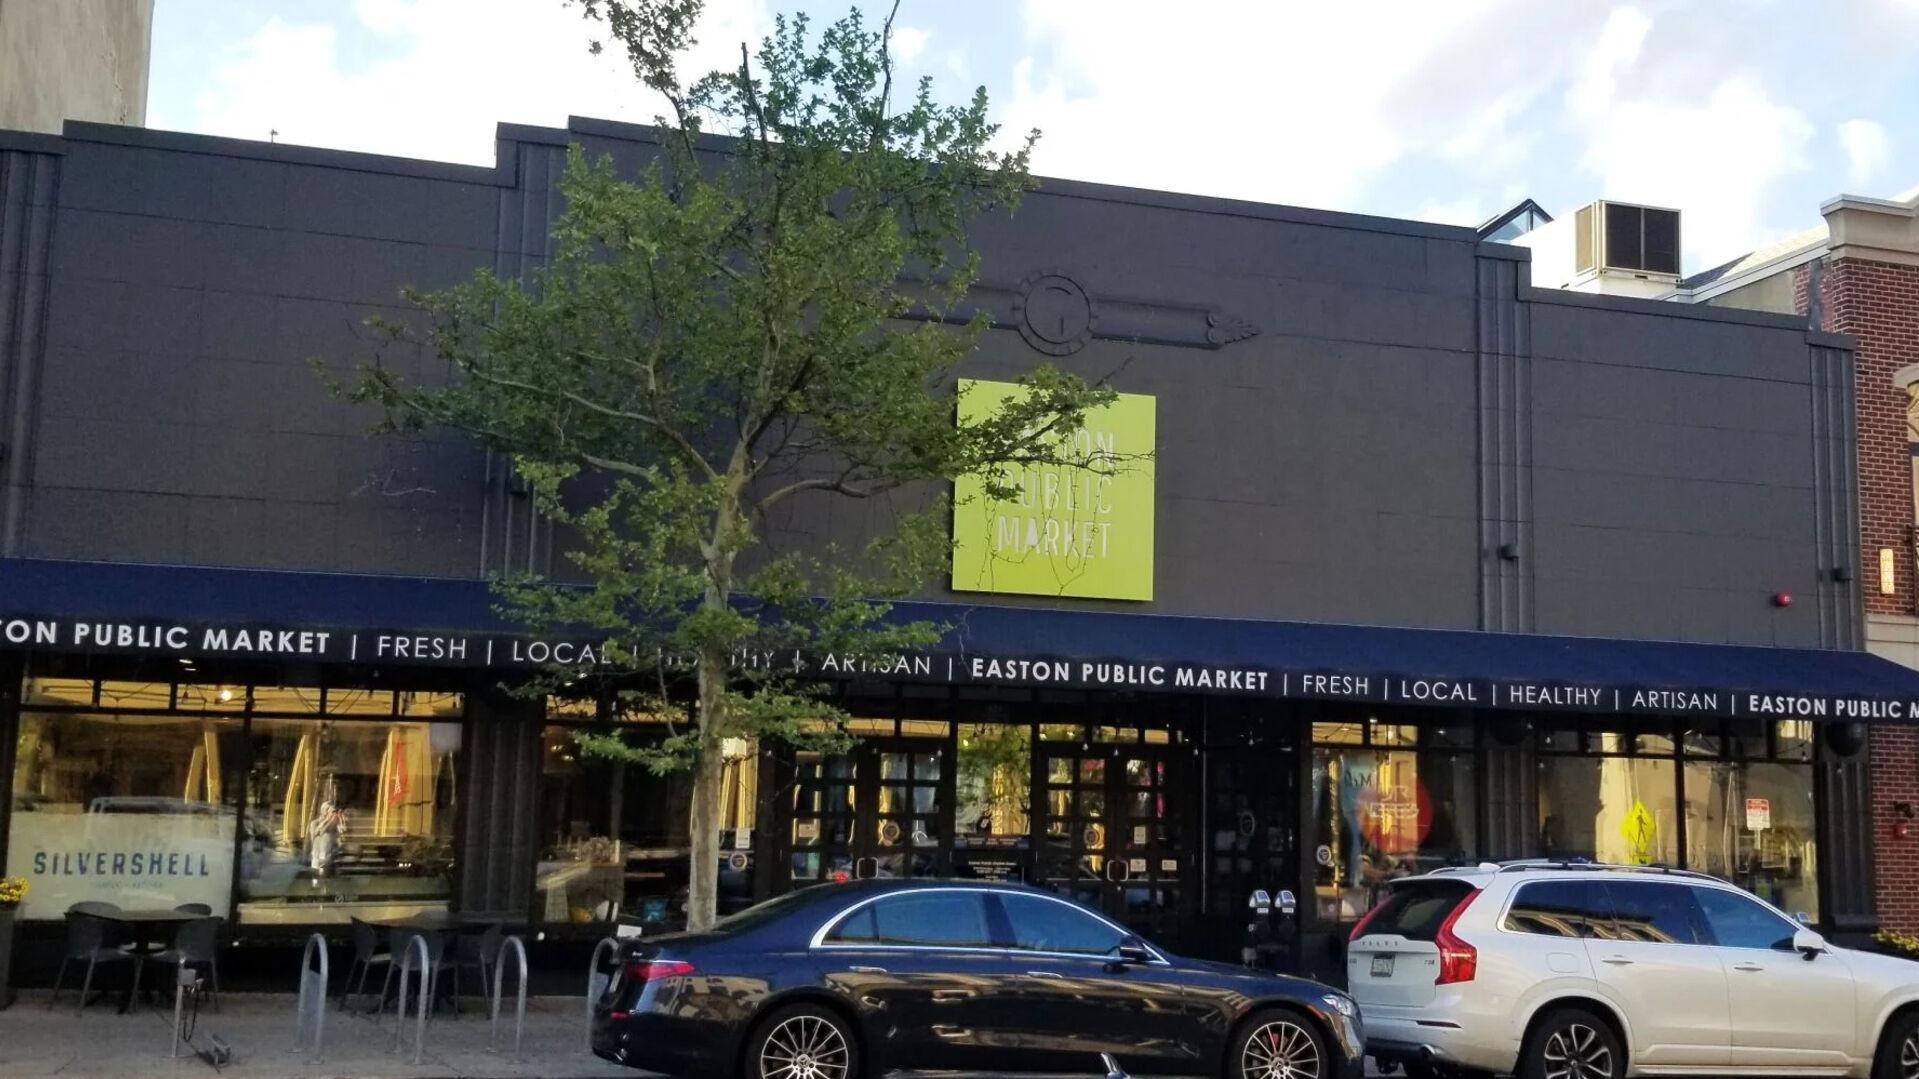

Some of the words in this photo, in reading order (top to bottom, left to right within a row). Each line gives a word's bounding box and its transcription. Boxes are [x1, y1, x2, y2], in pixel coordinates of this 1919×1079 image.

[996, 515, 1111, 558] MARKET
[0, 619, 56, 644] ON
[74, 623, 189, 649] PUBLIC
[202, 628, 330, 653] MARKET
[377, 635, 467, 659] FRESH
[512, 640, 612, 664] LOCAL
[821, 652, 931, 675] ARTSAN
[972, 658, 1070, 681] EASTON
[1082, 663, 1165, 685] PUBLIC
[1175, 667, 1268, 690] MARKET
[1302, 674, 1369, 695] FRESH
[1401, 680, 1478, 701] LOCAL
[1510, 685, 1601, 705] HEALTHY
[1631, 690, 1718, 710] ARTISAN
[1749, 695, 1827, 715] EASTON
[1835, 699, 1903, 719] PUBLIC
[33, 851, 210, 877] SILVERSHELL
